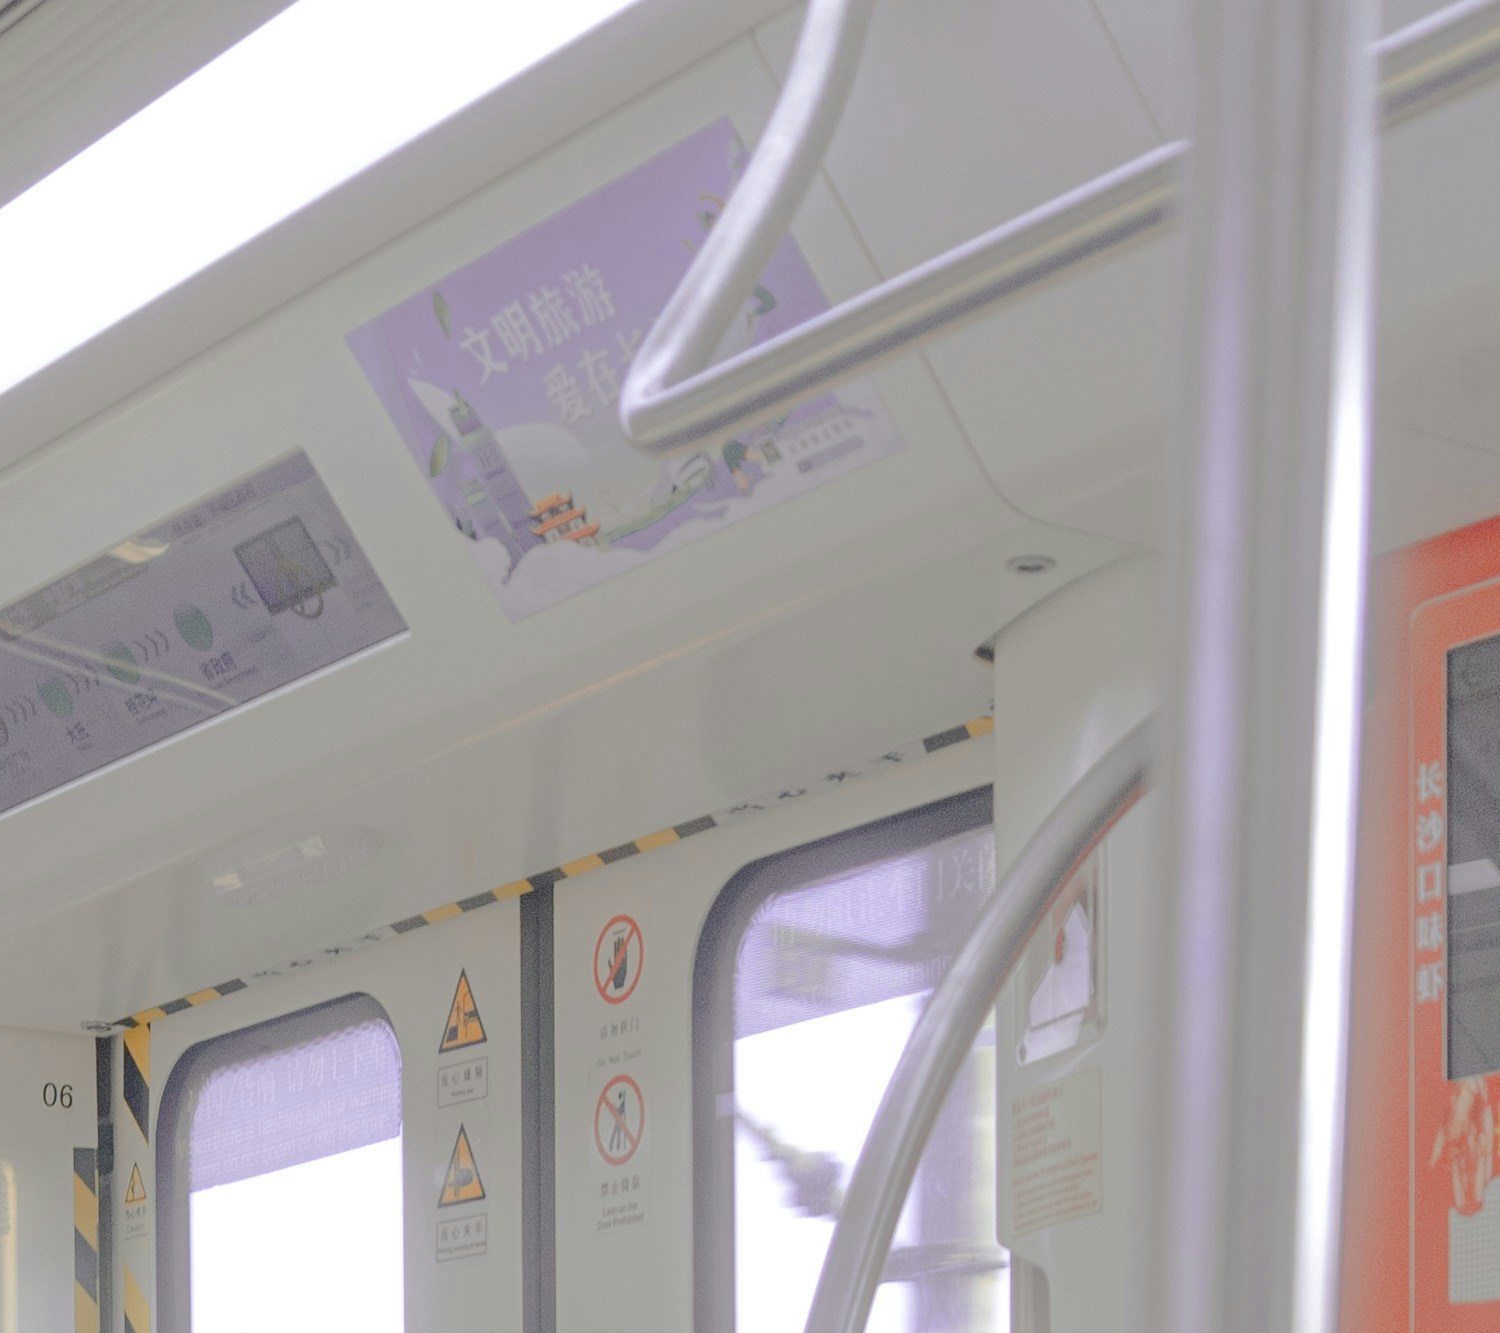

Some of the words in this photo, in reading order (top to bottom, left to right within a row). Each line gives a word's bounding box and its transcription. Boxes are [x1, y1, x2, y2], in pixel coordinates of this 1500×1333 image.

[459, 262, 616, 386] 文明旅游
[1416, 762, 1444, 1003] 长沙口味虾
[43, 1082, 73, 1109] 06
